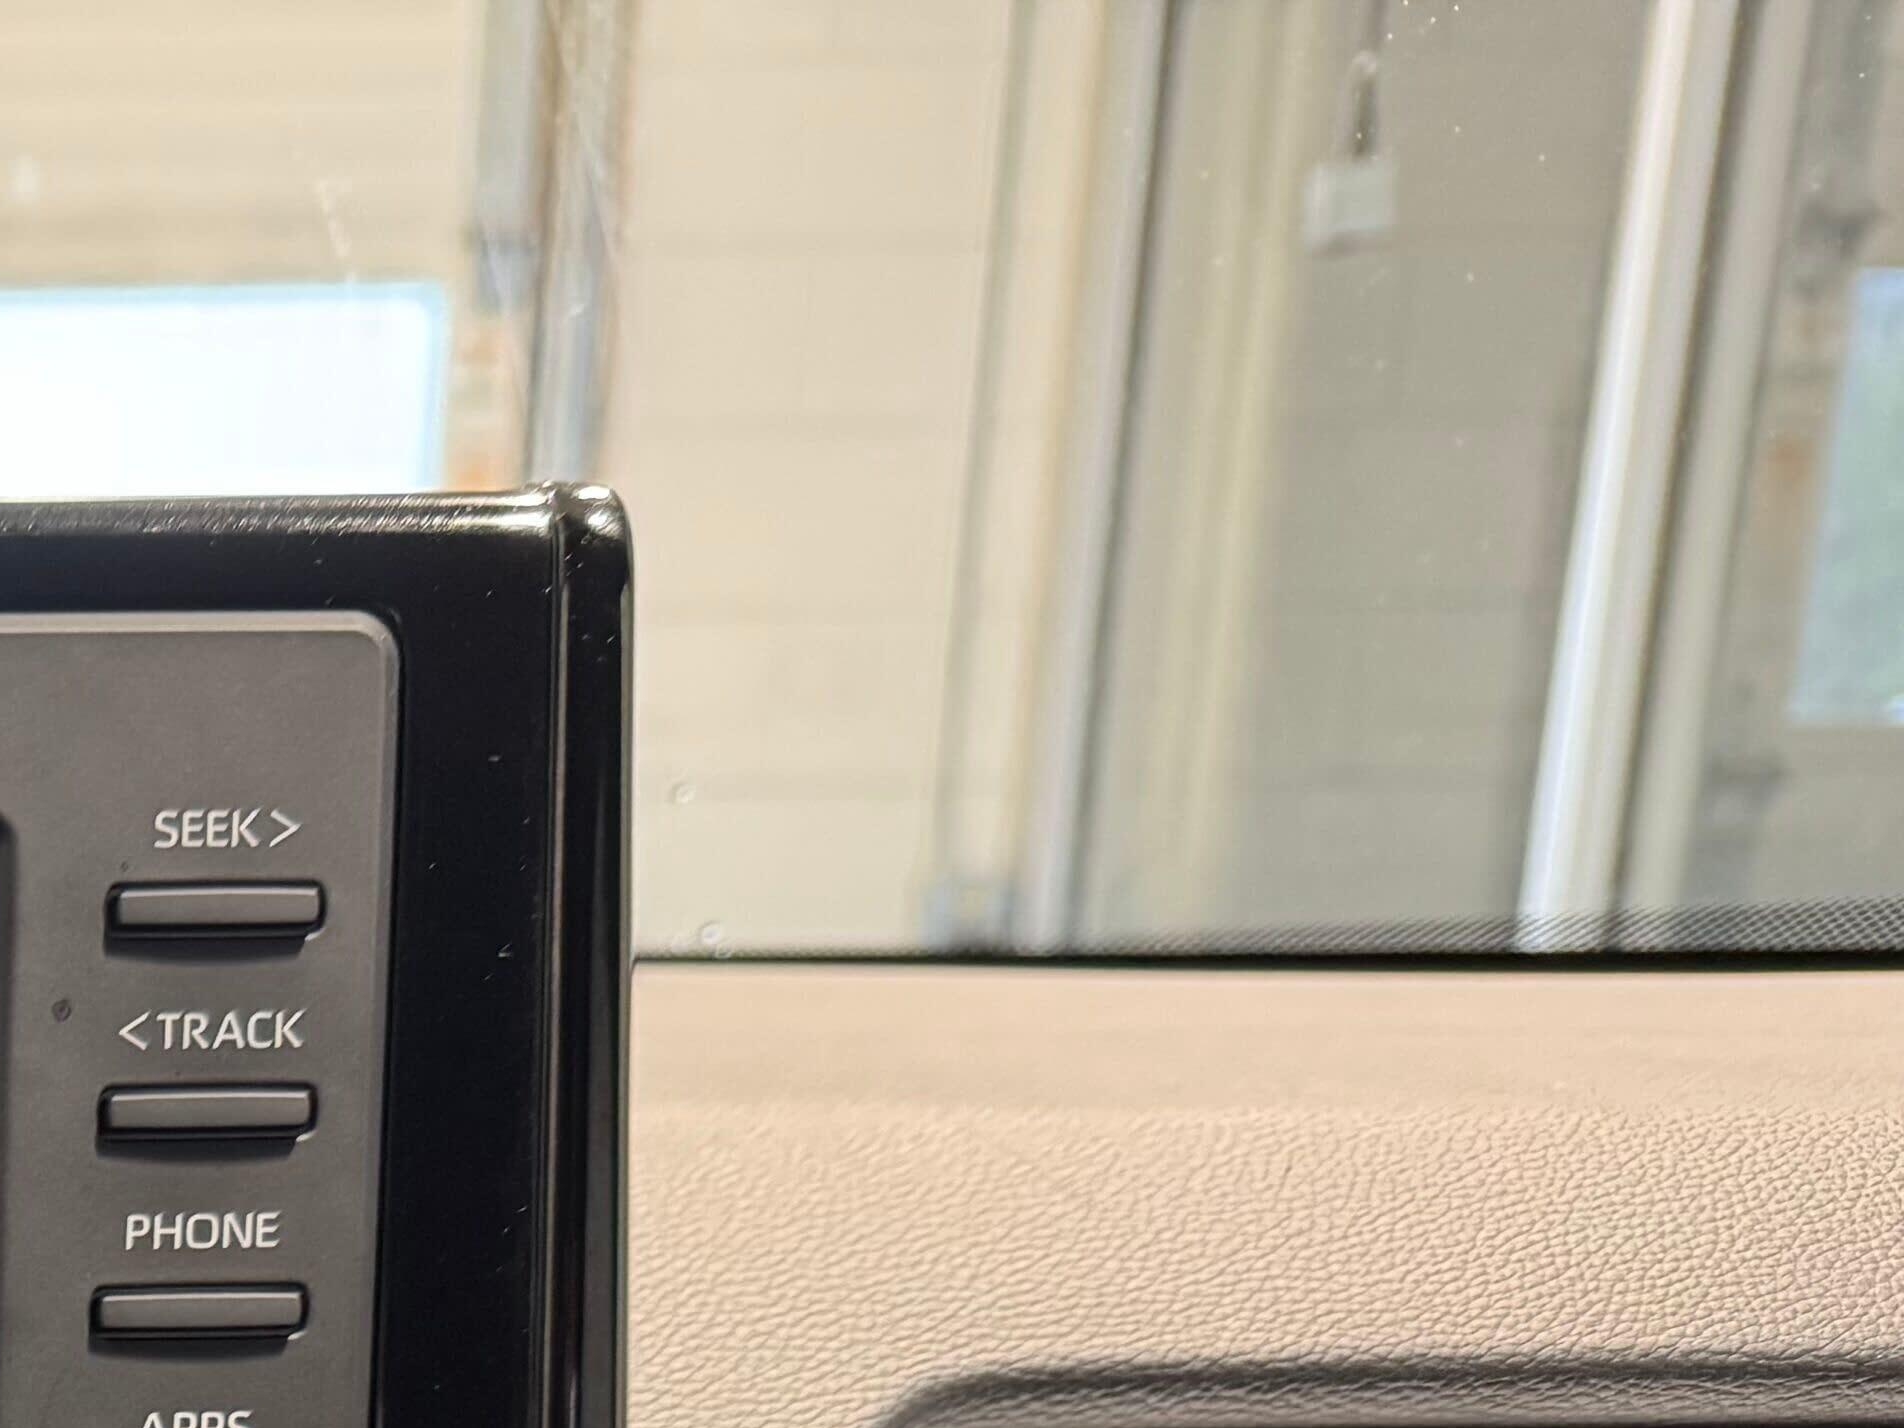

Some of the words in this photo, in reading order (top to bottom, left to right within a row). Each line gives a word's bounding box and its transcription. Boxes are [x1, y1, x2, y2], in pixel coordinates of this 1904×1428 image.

[154, 807, 261, 849] SEEK
[156, 1009, 305, 1050] TRACK
[125, 1211, 280, 1251] PHONE
